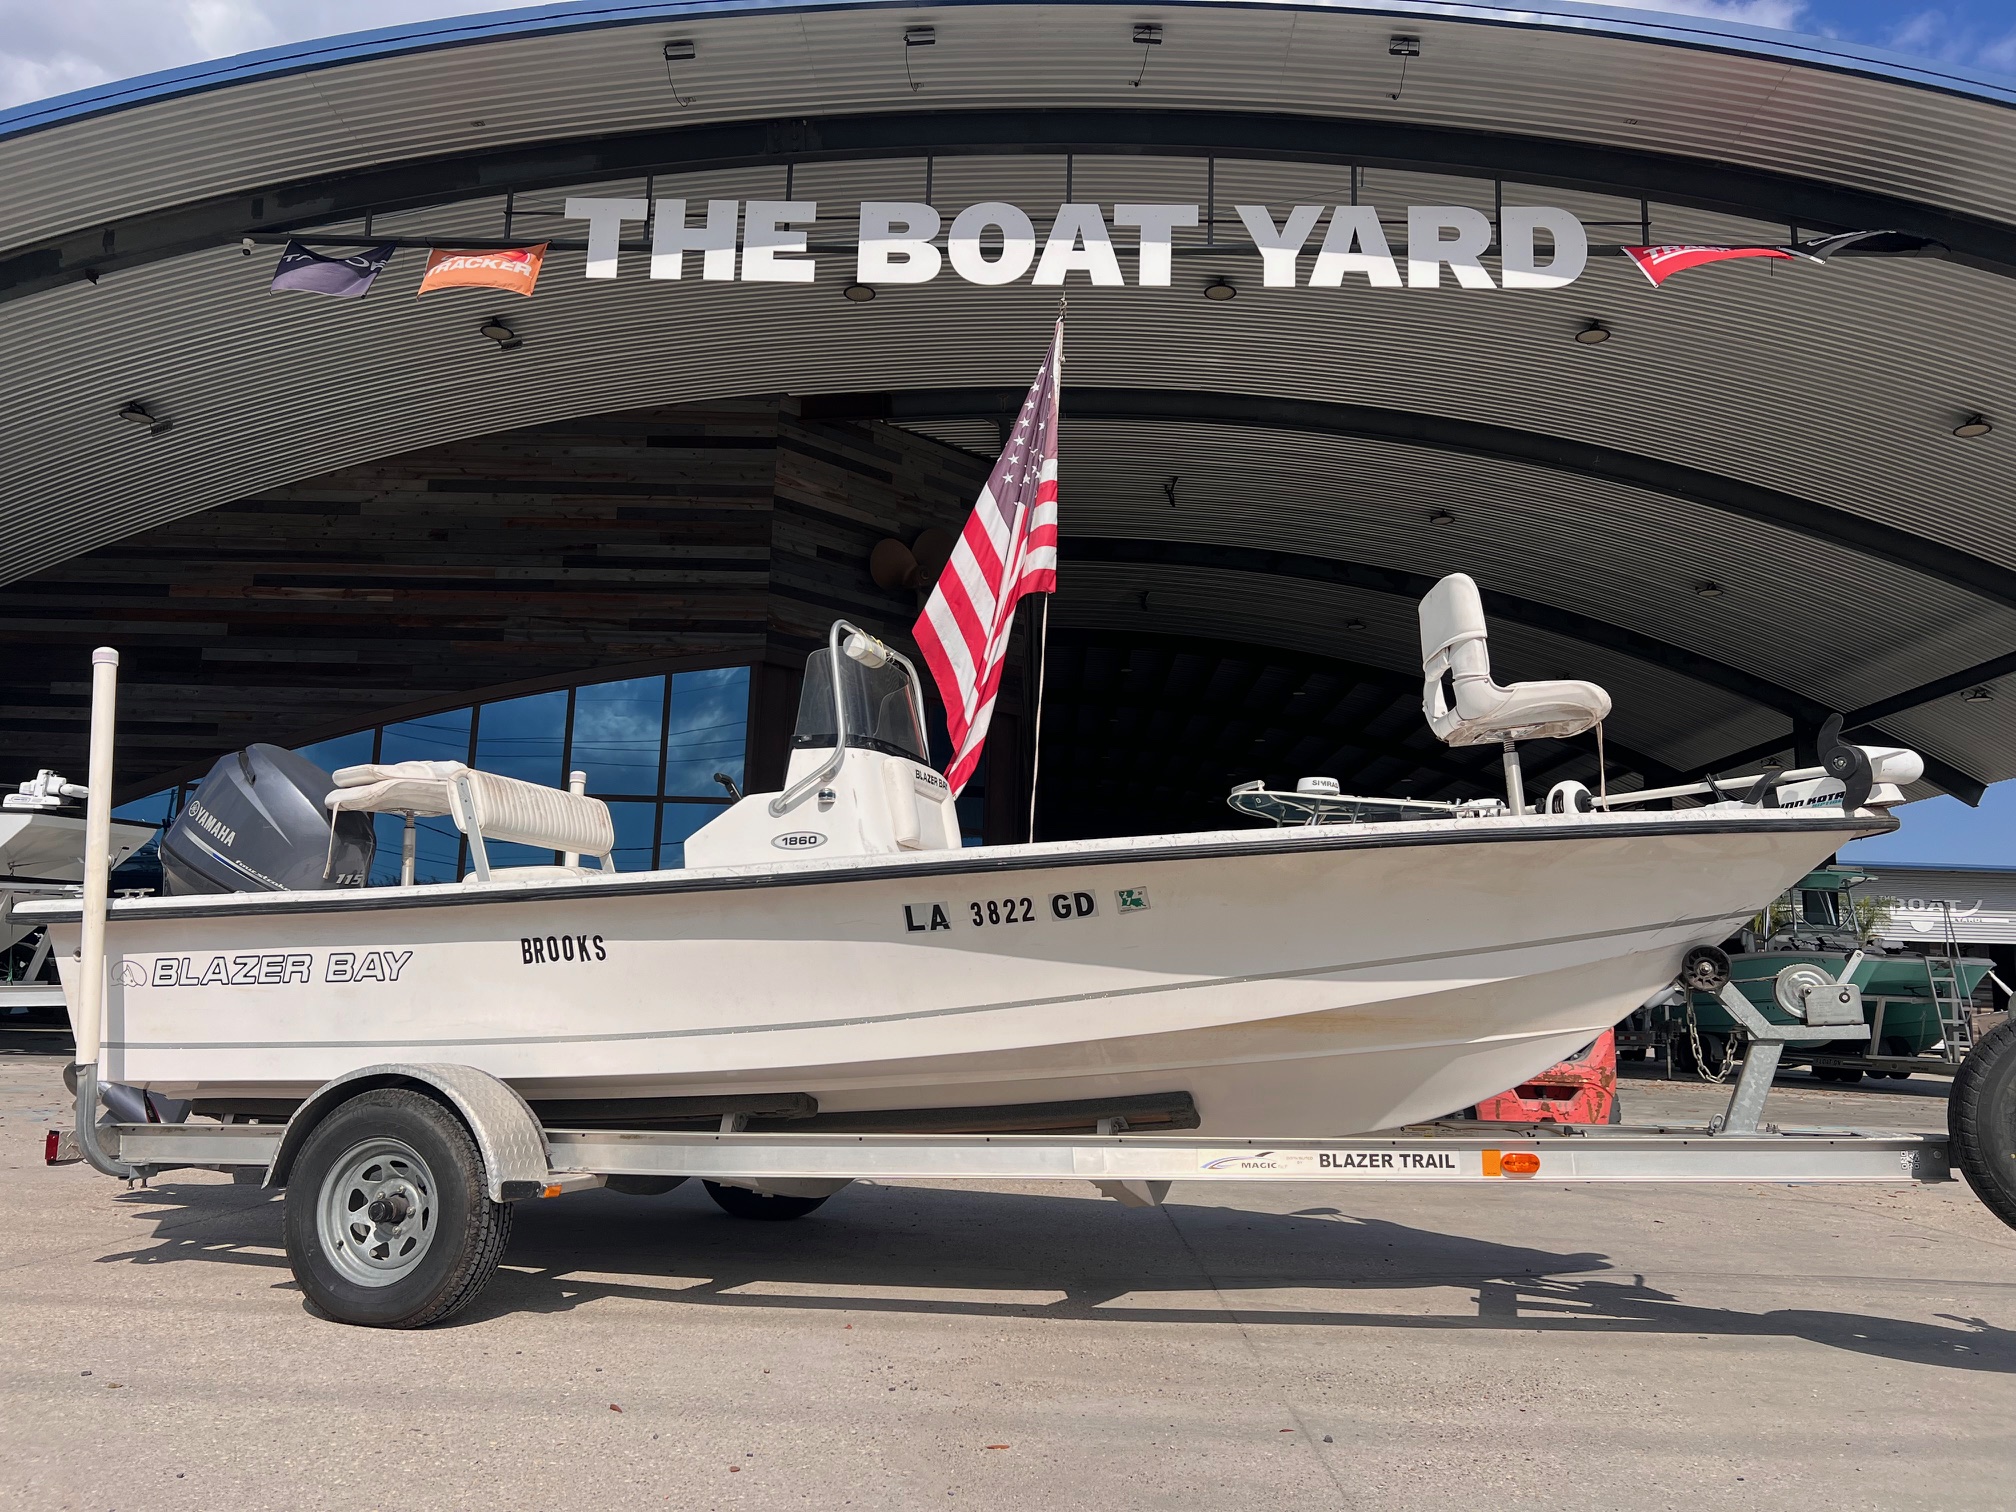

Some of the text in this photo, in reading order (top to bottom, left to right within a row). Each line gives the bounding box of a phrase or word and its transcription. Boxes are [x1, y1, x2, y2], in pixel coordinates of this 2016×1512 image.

[564, 198, 1588, 289] THE BOAT YARD
[915, 769, 938, 787] BLAZER
[1807, 791, 1846, 806] KOTA
[195, 806, 236, 847] YAMAHA
[781, 835, 818, 846] 1860
[336, 873, 365, 886] 115
[904, 892, 1095, 932] LA 3822 GD
[520, 934, 607, 965] BROOKS
[152, 951, 413, 988] BLAZER BAY
[1319, 1153, 1456, 1169] BLAZER TRAIL
